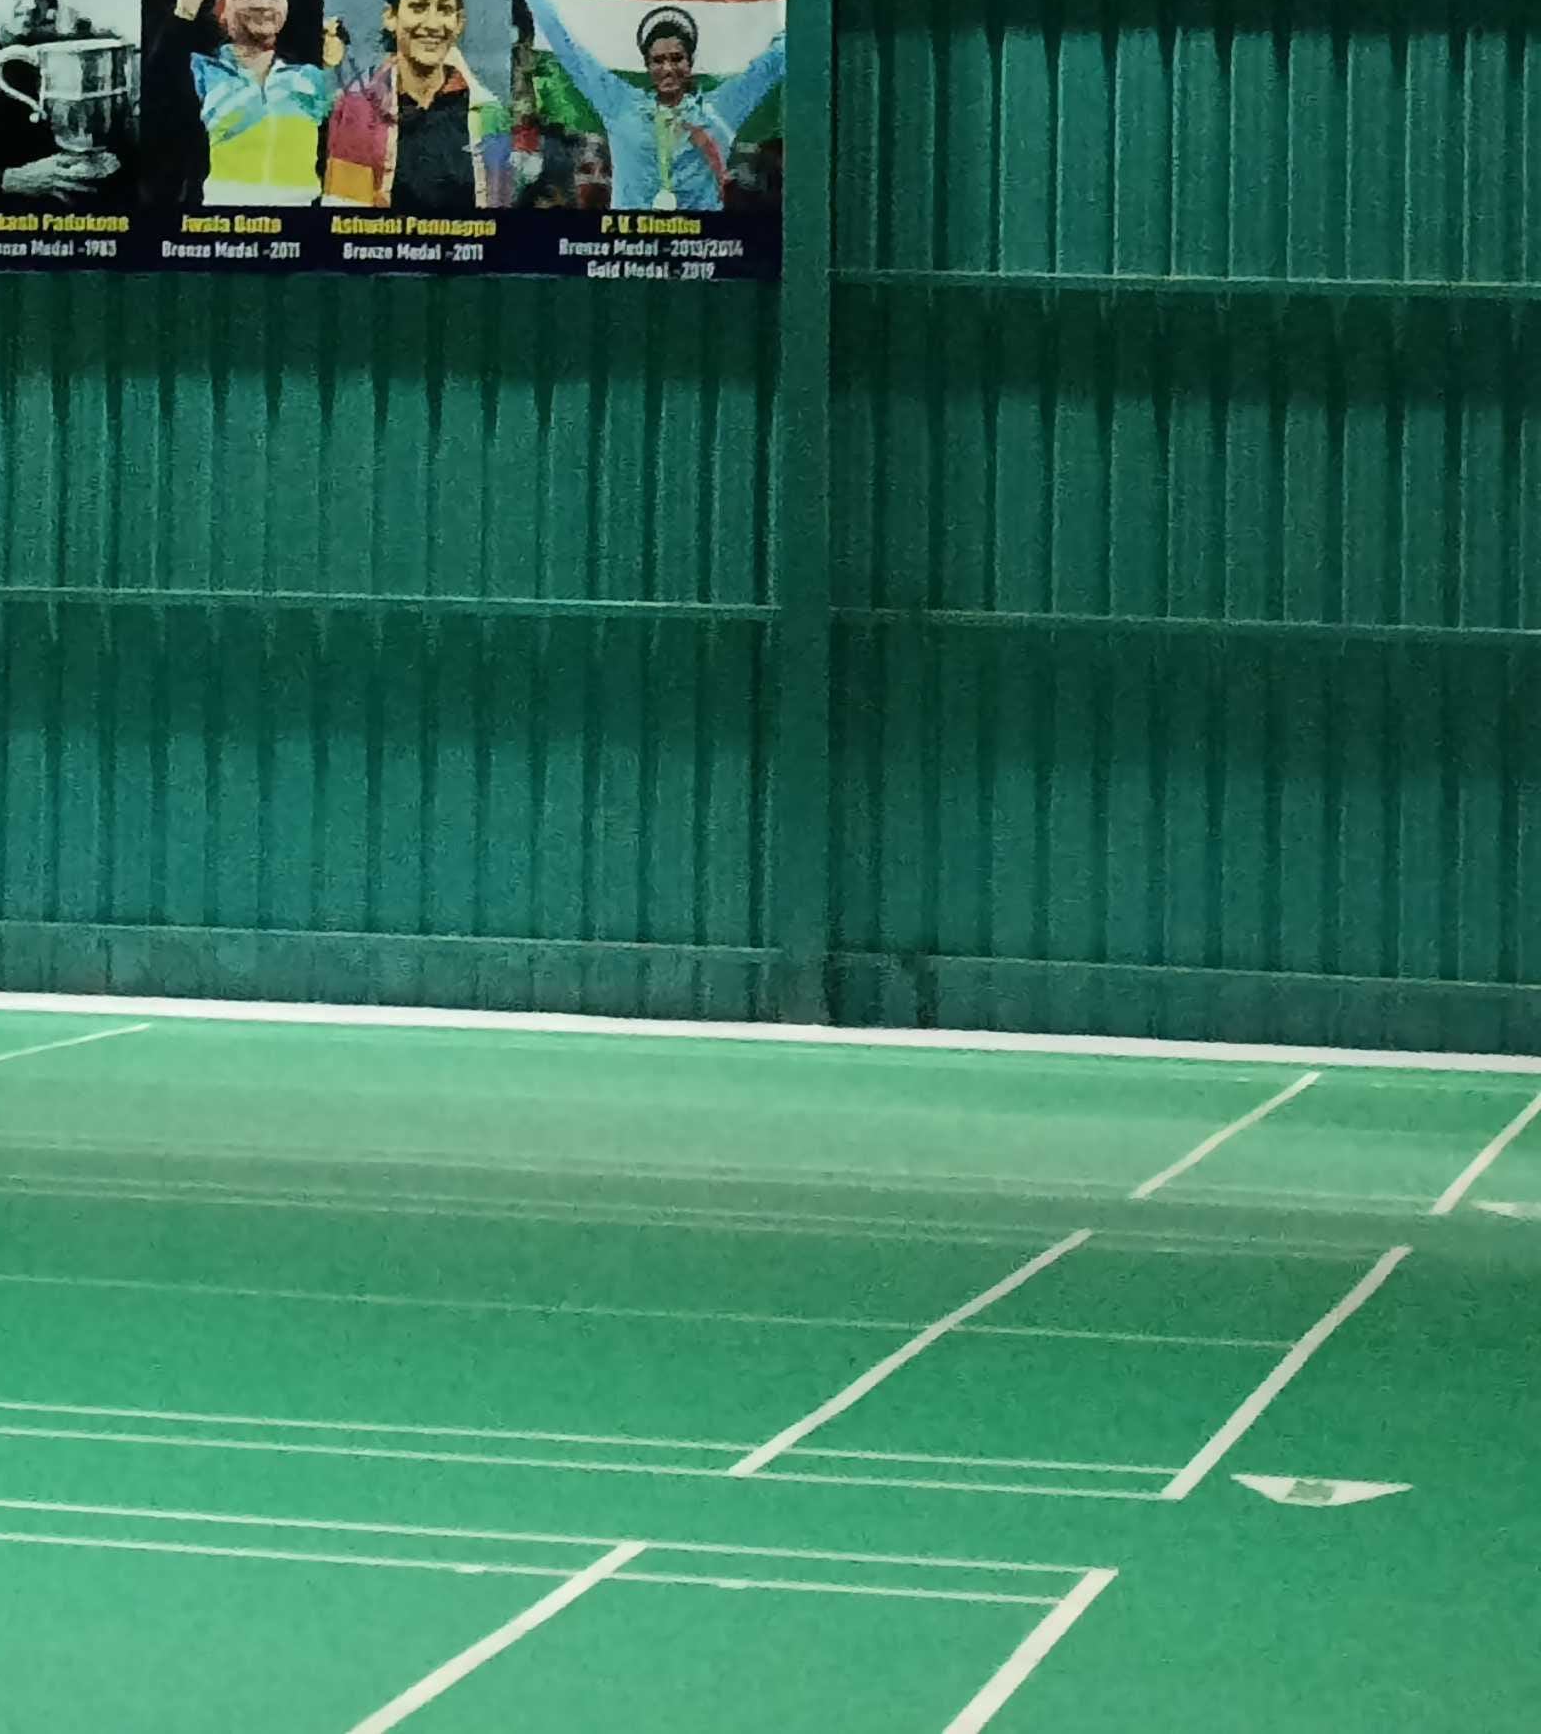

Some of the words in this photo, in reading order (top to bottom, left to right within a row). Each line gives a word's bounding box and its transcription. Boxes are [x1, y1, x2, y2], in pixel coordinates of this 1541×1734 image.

[42, 214, 130, 233] Padukone
[31, 239, 74, 257] Medal
[161, 240, 211, 258] Bronze
[215, 241, 259, 259] Medal
[342, 242, 393, 260] Bronze
[397, 243, 441, 261] Medal
[558, 238, 610, 256] Bronze
[614, 239, 659, 257] Medal
[587, 260, 620, 278] Gold
[624, 261, 669, 279] Medal
